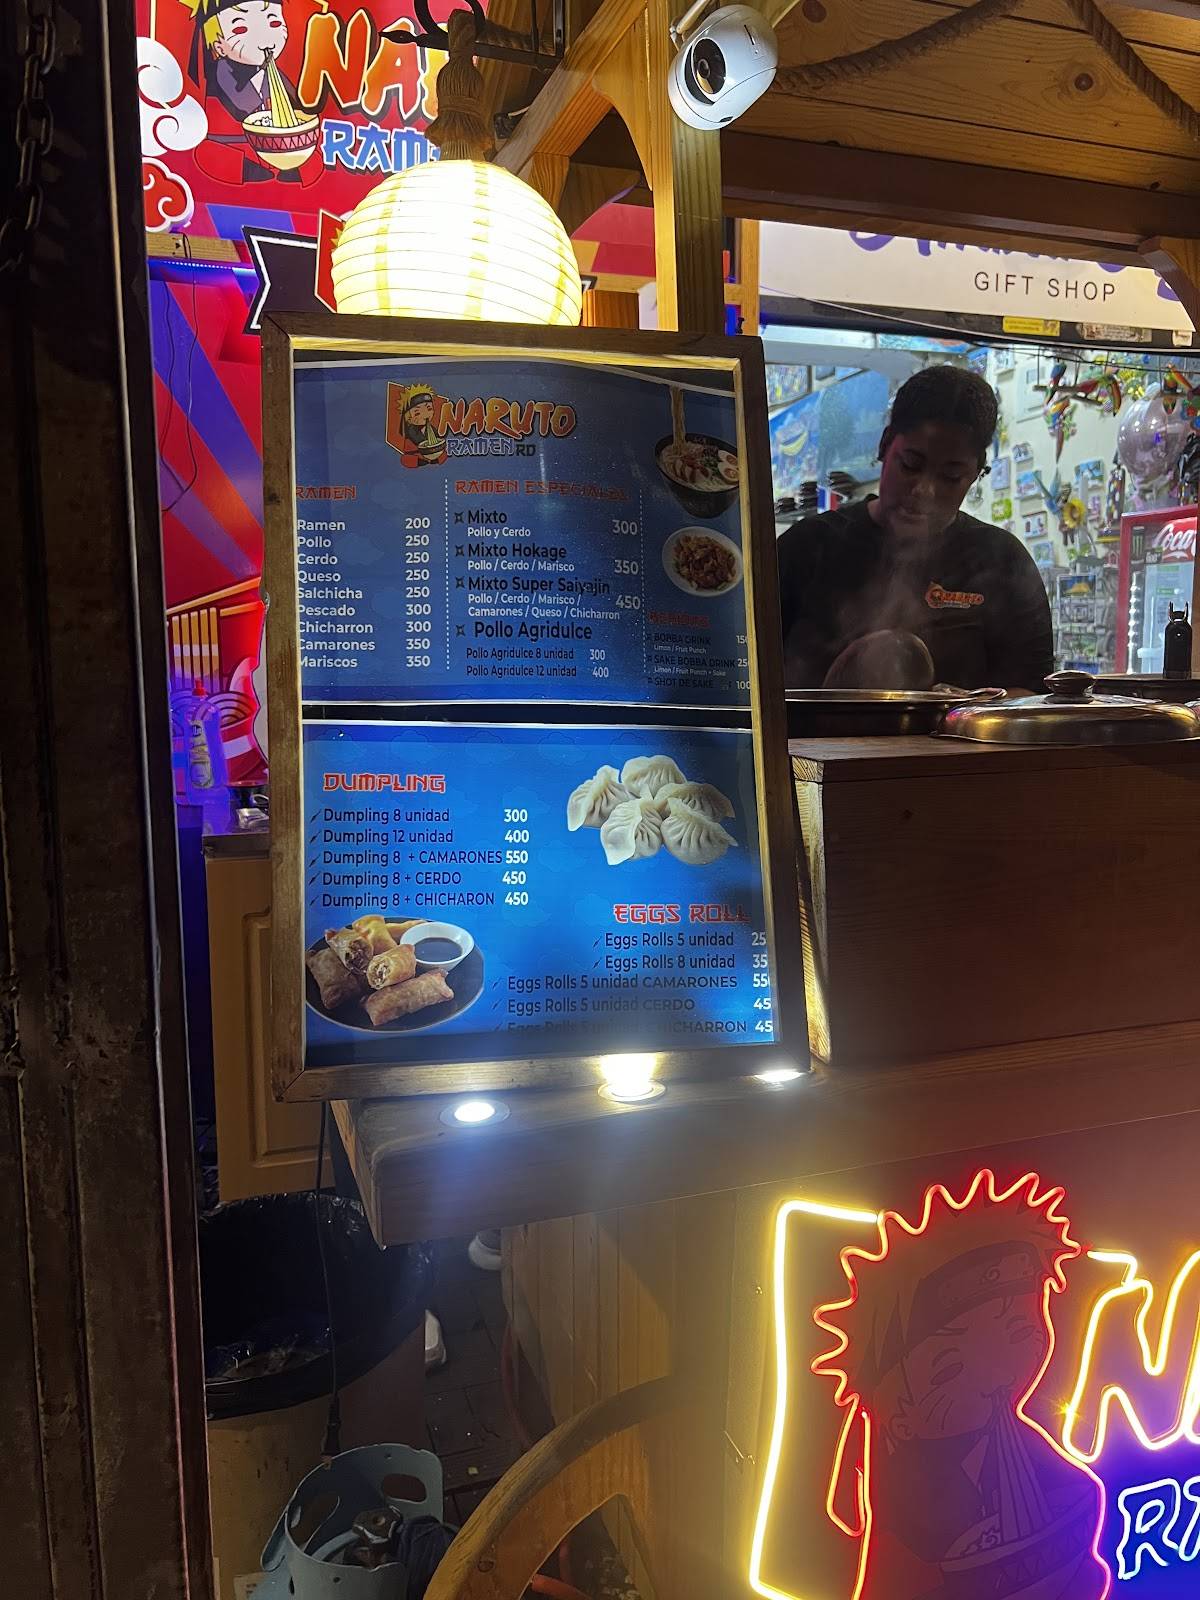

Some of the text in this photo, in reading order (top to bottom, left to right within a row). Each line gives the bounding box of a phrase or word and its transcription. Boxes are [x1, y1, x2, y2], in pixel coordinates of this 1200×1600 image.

[298, 8, 450, 121] NA
[321, 118, 442, 174] RAM
[974, 271, 1034, 295] GIFT
[1047, 278, 1115, 302] SHOP
[438, 397, 577, 440] NARUTO
[446, 437, 537, 457] RAMEN RD
[295, 485, 357, 500] RAMEN
[455, 479, 519, 495] RAMEN
[297, 517, 431, 531] Ramen 200
[468, 509, 638, 535] Mixto 300
[297, 534, 430, 548] Pollo 250
[467, 526, 531, 539] Pollo y Cerdo
[297, 552, 430, 565] Cerdo 250
[467, 560, 492, 571] Pollo
[500, 560, 530, 571] Cerdo
[538, 561, 575, 572] Marisco
[468, 543, 639, 575] Mixto Hokage 350
[298, 569, 430, 584] Queso 250
[298, 586, 430, 599] Salchicha 250
[468, 575, 610, 597] Mixto Super Saiyajin
[299, 603, 431, 617] Pescado 300
[468, 594, 493, 604] Pollo
[500, 593, 530, 604] Cerdo
[538, 594, 575, 605] Marisco
[615, 595, 641, 610] 450
[468, 607, 523, 617] Camarones
[531, 607, 562, 618] Queso
[570, 607, 620, 620] Chicharron
[299, 621, 431, 633] Chicharron 300
[475, 621, 592, 642] Pollo Agridulce
[300, 638, 431, 651] Camarones 350
[300, 655, 431, 668] Mariscos 350
[466, 647, 606, 661] Pollo Agridulce 8 unidad 300
[467, 665, 609, 678] Pollo Agridulce 12 unidad 400
[323, 772, 446, 793] DUMPLING
[323, 808, 528, 824] Dumpling 8 unidad 300
[323, 829, 530, 846] Dumpling 12 unidad 400
[322, 851, 389, 867] Dumpling
[393, 851, 401, 864] 8
[419, 850, 502, 864] CAMARONES
[505, 850, 528, 864] 550
[322, 872, 388, 889] Dumpling
[393, 872, 401, 885] 8
[415, 871, 462, 885] CERDO
[502, 871, 526, 885] 450
[322, 892, 388, 910] Dumpling
[393, 893, 401, 906] 8
[415, 892, 495, 906] CHICHARON
[504, 891, 529, 906] 450
[613, 903, 681, 925] EGGS
[605, 932, 638, 949] Eggs
[642, 931, 673, 946] Rolls
[677, 932, 685, 946] 5
[689, 931, 734, 946] unidad
[605, 955, 638, 971] Eggs
[642, 954, 674, 969] Rolls
[677, 955, 685, 968] 8
[690, 954, 735, 969] unidad
[508, 976, 541, 993] Eggs
[545, 974, 577, 990] Rolls
[580, 974, 588, 989] 5
[592, 973, 638, 989] unidad
[642, 976, 738, 988] CAMARONES
[508, 999, 541, 1016] Eggs
[545, 998, 577, 1013] Rolls
[580, 998, 588, 1012] 5
[592, 996, 638, 1012] unidad
[642, 999, 695, 1011] CERDO
[1062, 1249, 1200, 1463] N
